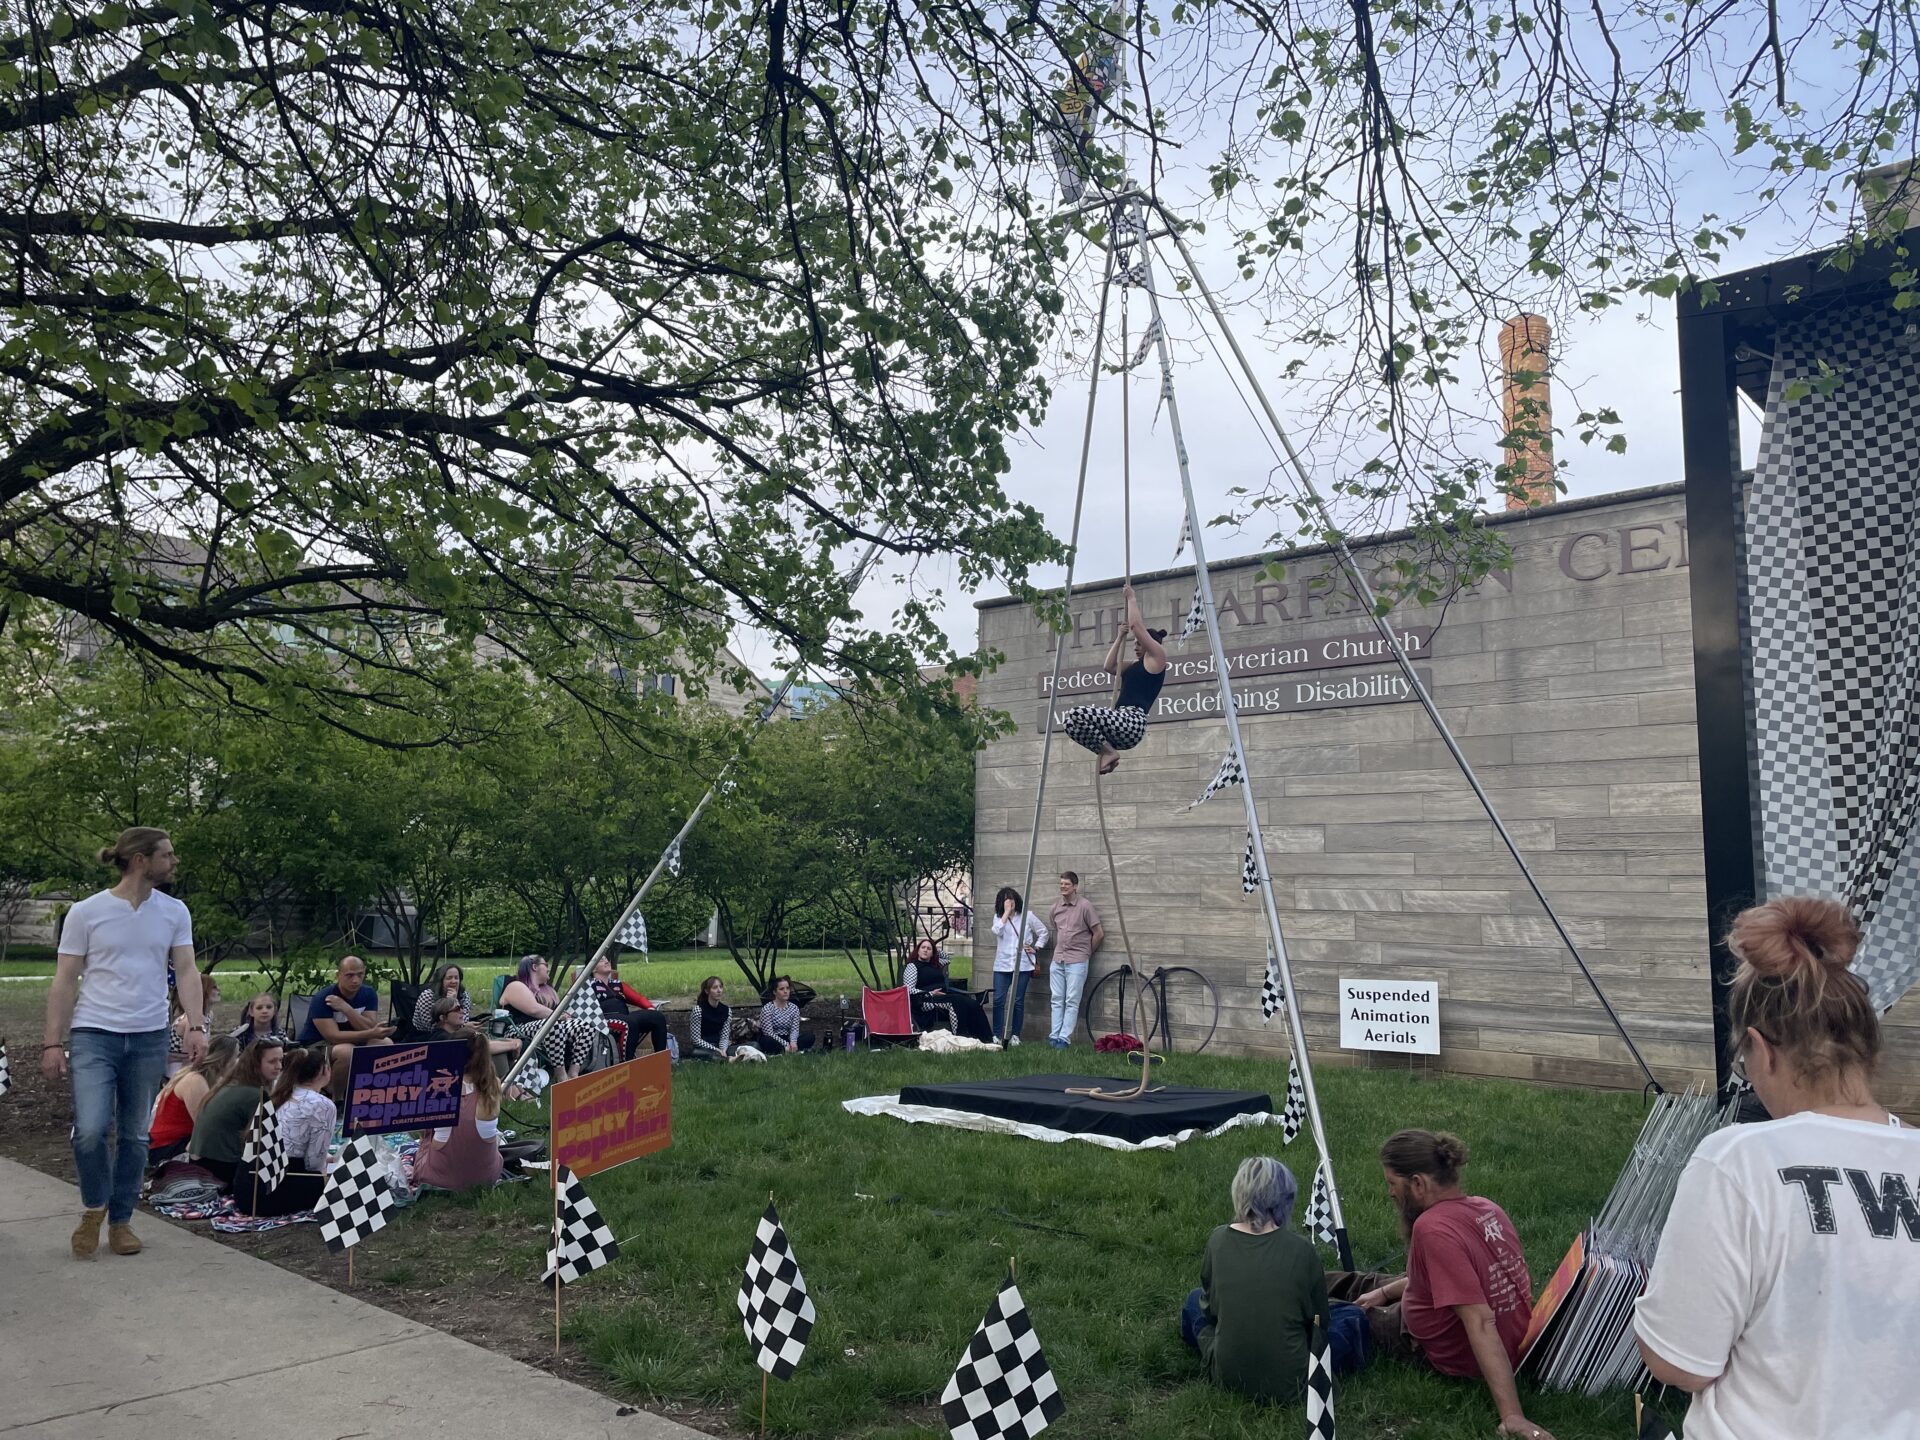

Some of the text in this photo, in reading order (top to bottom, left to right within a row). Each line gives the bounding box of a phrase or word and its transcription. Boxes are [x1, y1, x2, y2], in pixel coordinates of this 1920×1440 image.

[1157, 673, 1414, 716] Redefning Disability
[1347, 987, 1430, 1003] Suspended
[1350, 1007, 1430, 1024] Animation
[1364, 1028, 1417, 1044] Aerials
